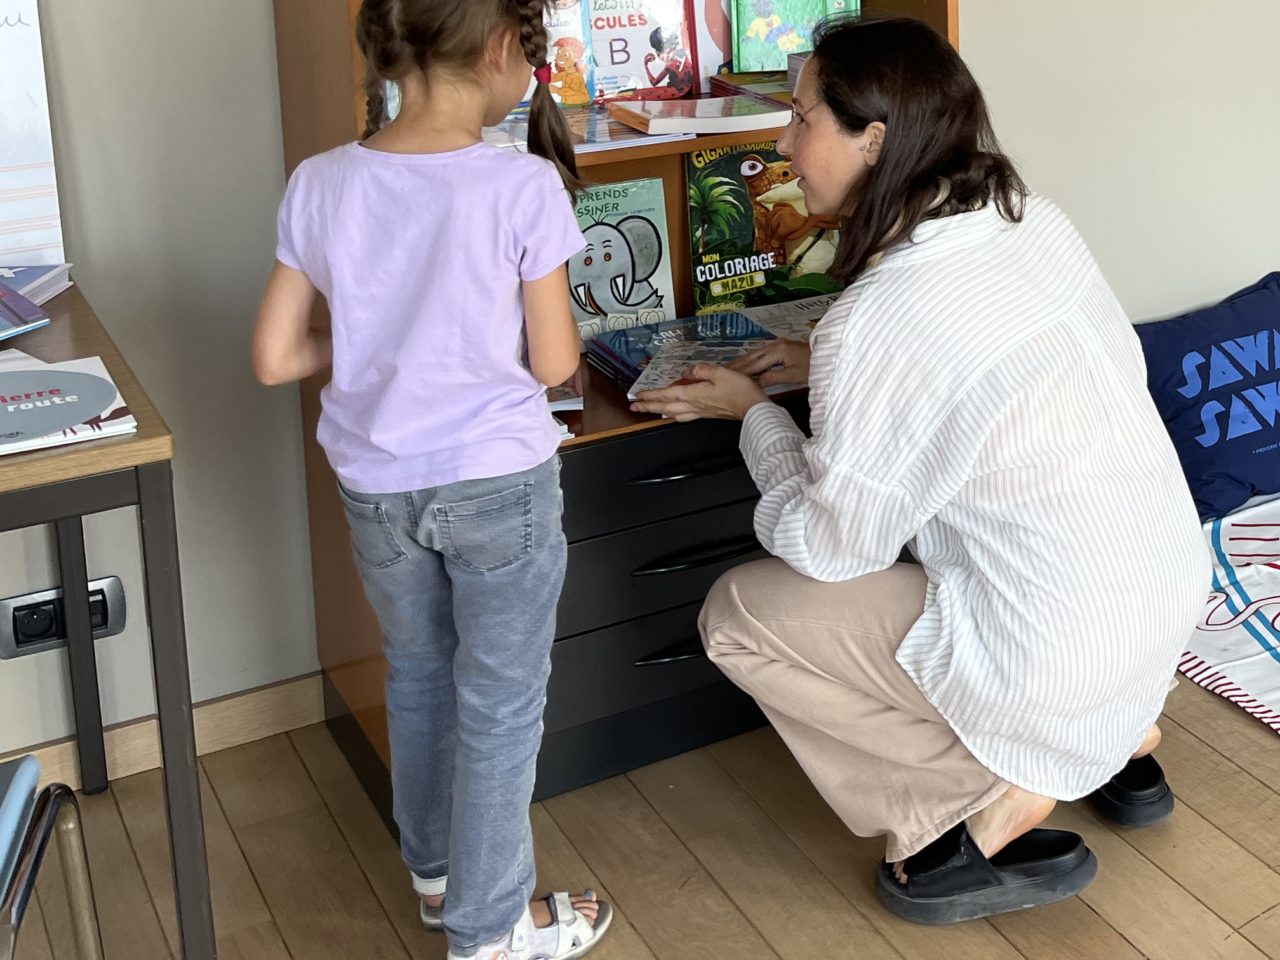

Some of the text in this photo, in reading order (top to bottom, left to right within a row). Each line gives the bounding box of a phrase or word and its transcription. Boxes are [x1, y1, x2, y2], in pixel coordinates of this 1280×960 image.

[577, 188, 629, 204] PRENDS
[576, 202, 620, 218] SSINER
[702, 253, 720, 264] MON
[696, 252, 777, 282] COLORIAGE
[7, 395, 79, 412] route
